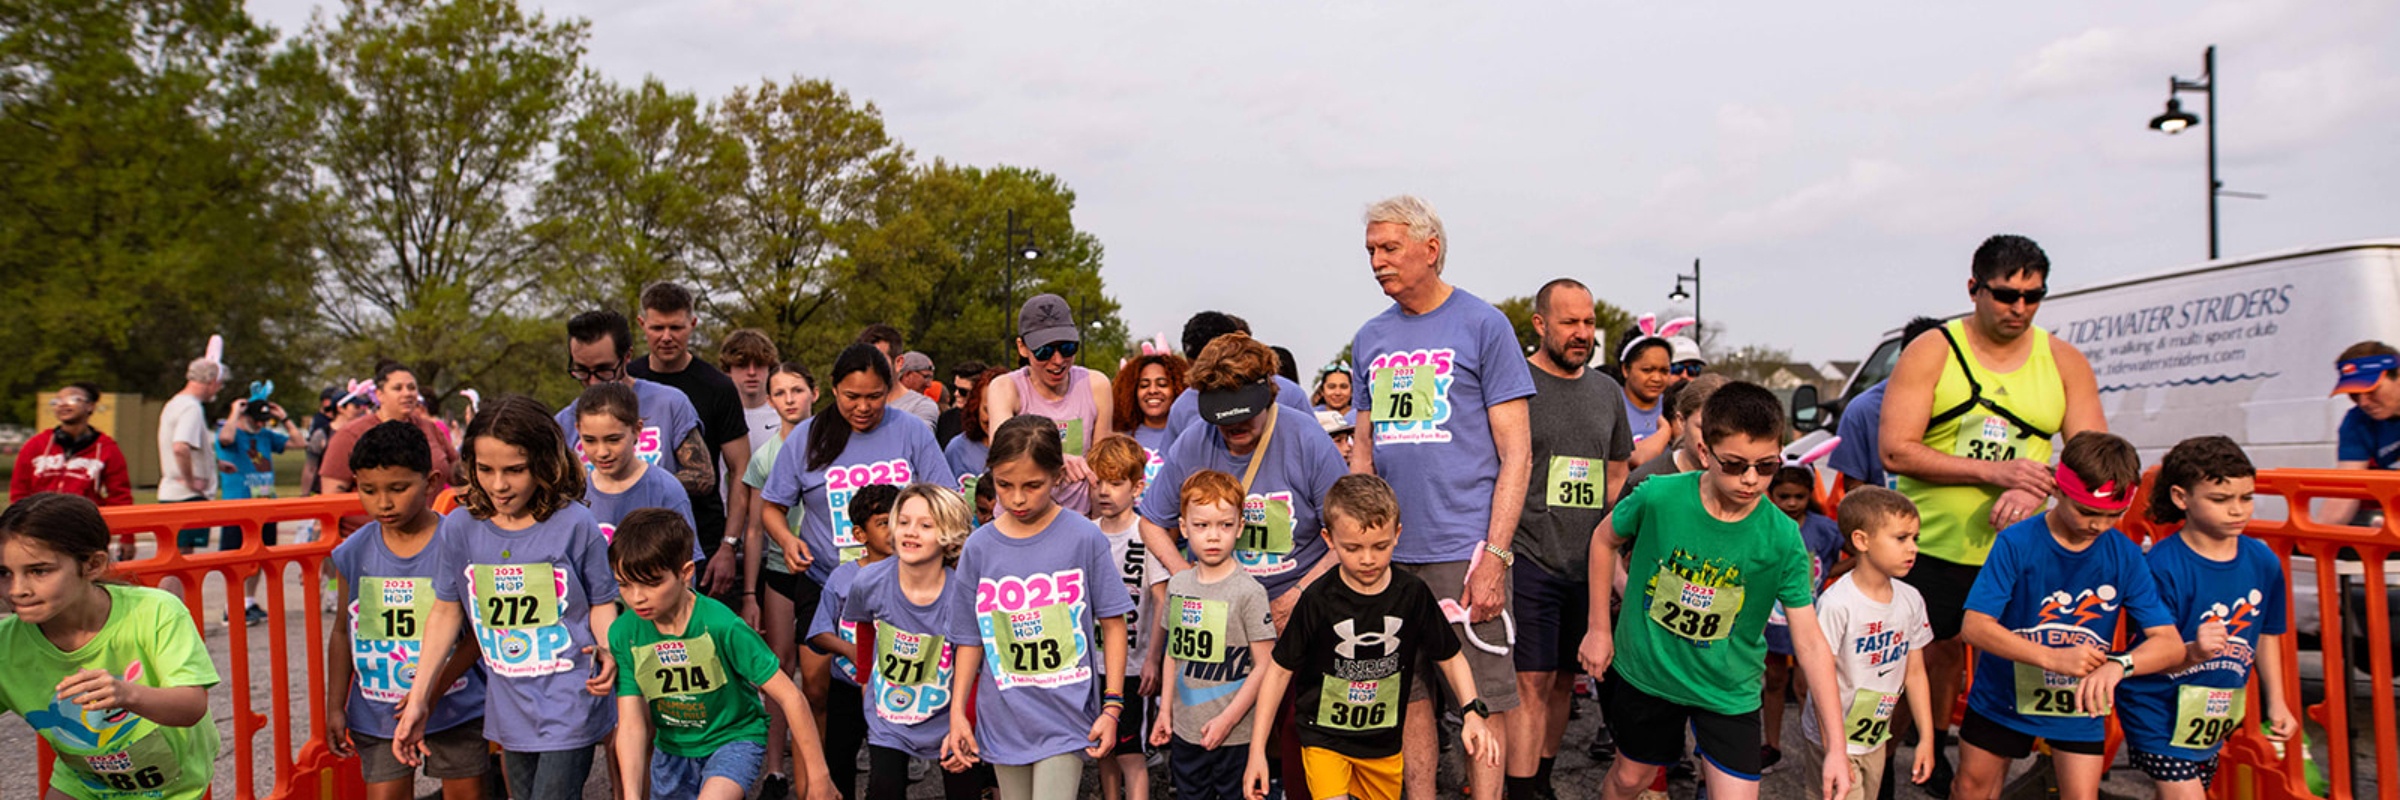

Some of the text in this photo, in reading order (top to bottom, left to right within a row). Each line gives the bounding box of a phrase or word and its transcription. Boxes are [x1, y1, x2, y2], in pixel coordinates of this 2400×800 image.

[2068, 284, 2295, 344] TIDEWATER STRIDERS
[2109, 341, 2154, 356] walking
[2169, 331, 2202, 347] multi
[2206, 327, 2243, 347] sport
[2245, 322, 2278, 338] club
[2095, 348, 2246, 376] w.tidewaterstriders.com
[1389, 392, 1413, 418] 76
[827, 461, 910, 490] 2025
[1559, 481, 1594, 506] 315
[495, 567, 523, 575] 2025
[1122, 538, 1146, 588] JUST
[384, 580, 413, 588] 2025
[495, 582, 524, 591] HOP
[977, 573, 1081, 613] 2025
[1684, 582, 1715, 596] 2025
[384, 594, 413, 603] HOP
[487, 595, 541, 627] 272
[1681, 594, 1711, 608] HOP
[382, 609, 415, 637] 15
[1010, 610, 1041, 623] 2025
[1661, 601, 1721, 638] 238
[1868, 620, 1882, 634] BE
[476, 623, 569, 664] HOP
[896, 631, 920, 643] 2025
[1014, 625, 1043, 638] HOP
[1172, 626, 1213, 659] 359
[1856, 630, 1894, 654] FAST
[655, 641, 685, 651] 2025
[660, 653, 688, 663] HOP
[1010, 638, 1061, 671] 273
[356, 657, 418, 689] HO
[655, 666, 710, 693] 274
[884, 653, 925, 683] 271
[2033, 688, 2080, 714] 29
[1330, 702, 1387, 729] 306
[2185, 717, 2236, 746] 298
